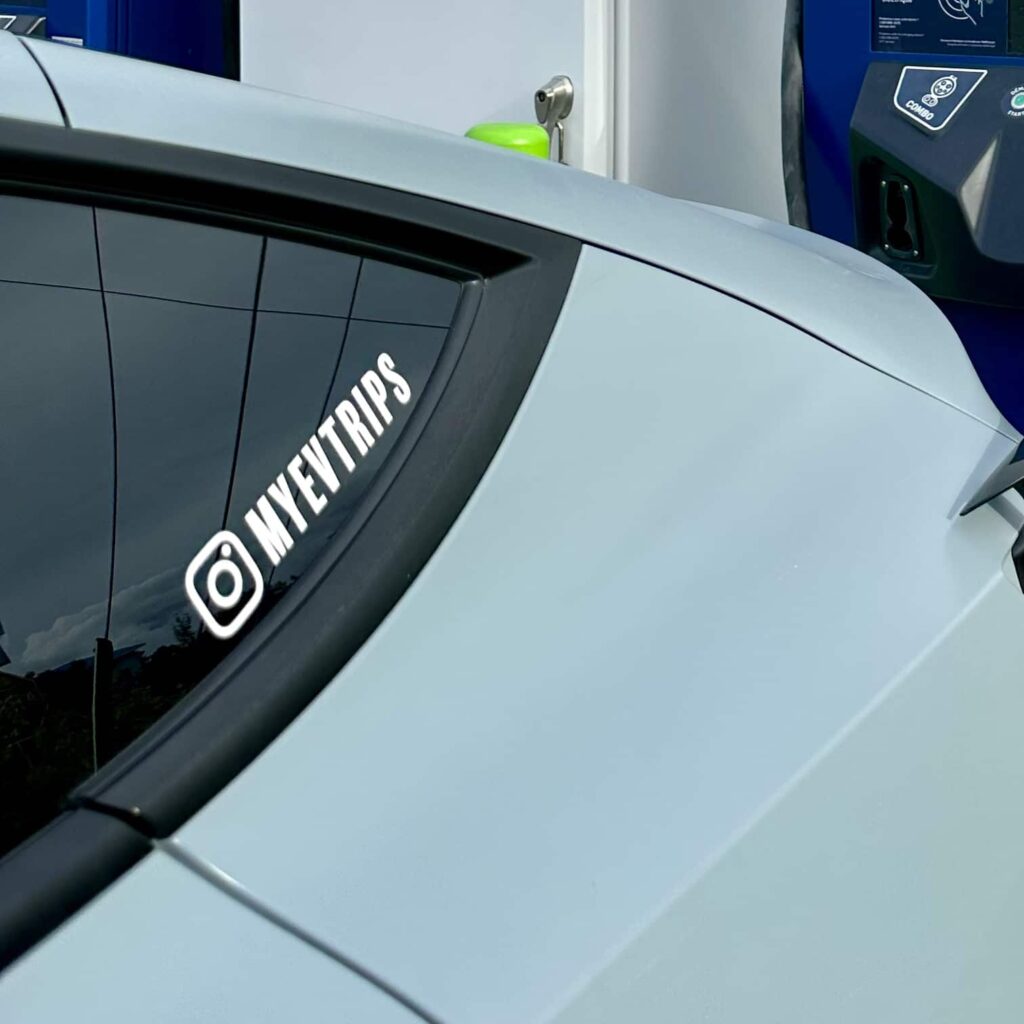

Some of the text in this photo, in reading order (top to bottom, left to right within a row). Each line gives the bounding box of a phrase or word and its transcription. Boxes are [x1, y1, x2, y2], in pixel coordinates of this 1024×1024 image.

[905, 100, 935, 121] COMBO
[1007, 109, 1024, 117] START
[244, 352, 412, 567] MYEVTRIPS
